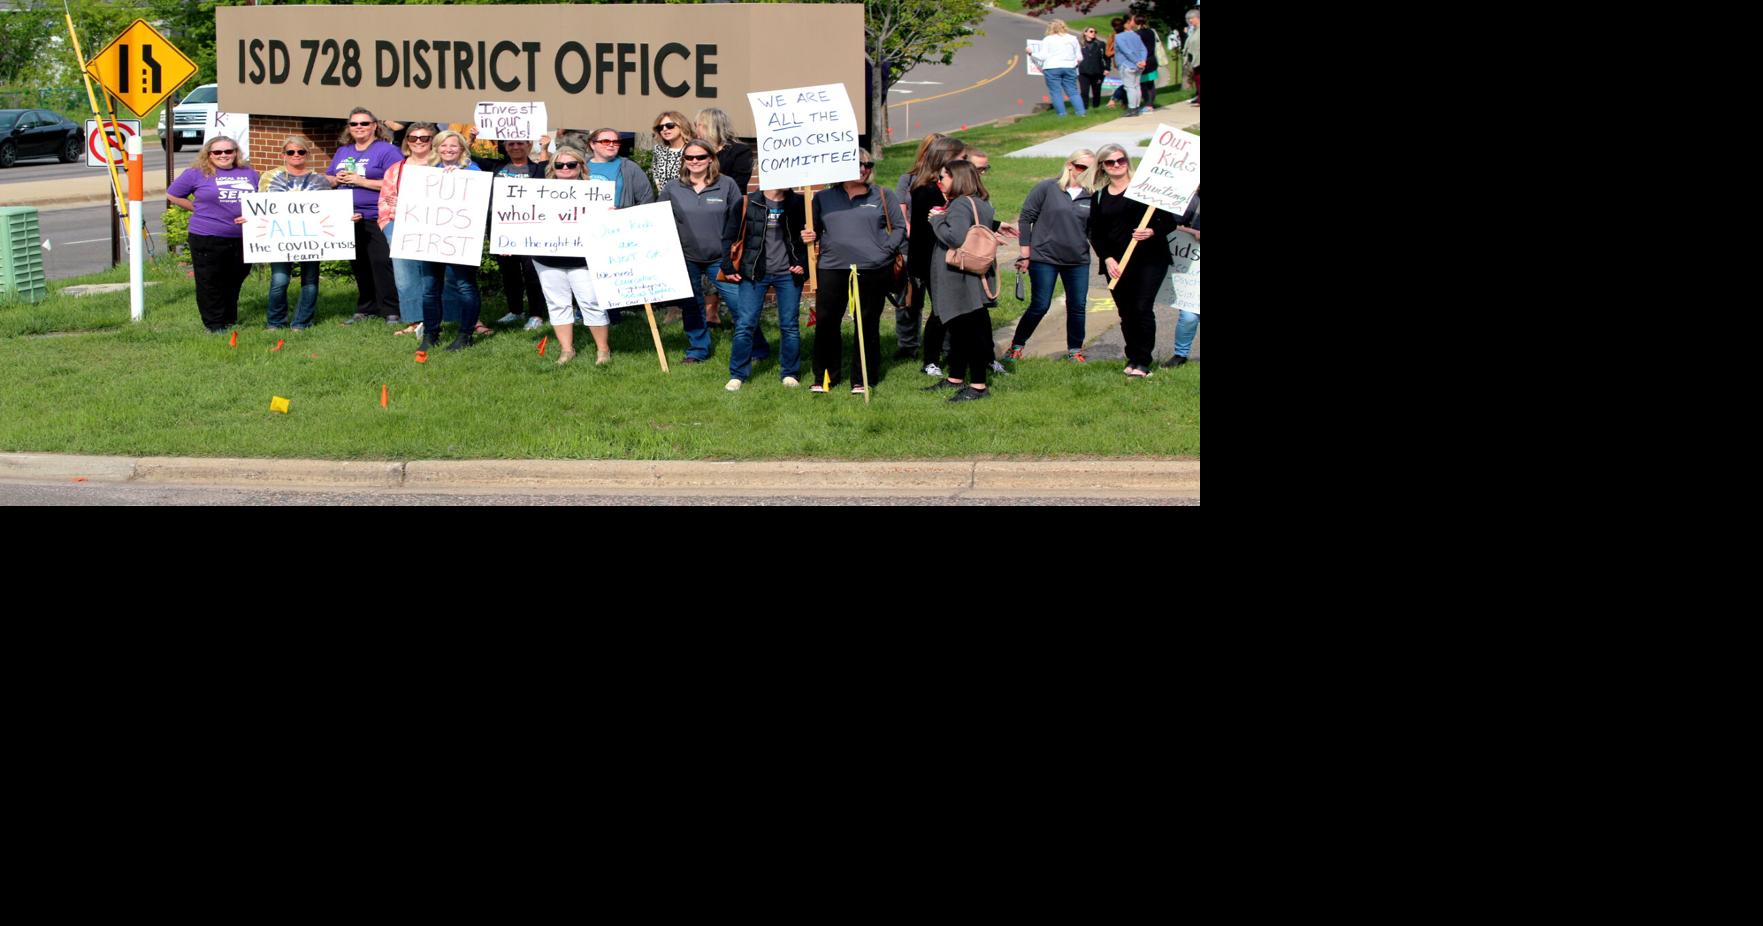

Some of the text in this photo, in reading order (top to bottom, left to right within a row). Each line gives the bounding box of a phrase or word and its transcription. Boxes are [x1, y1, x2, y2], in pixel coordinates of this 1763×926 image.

[239, 38, 718, 98] ISD 728 DISTRICT OFFICE
[478, 101, 538, 115] Invest
[757, 91, 831, 108] WE ARE
[480, 116, 521, 128] in our
[768, 110, 839, 127] ALL THE
[495, 121, 530, 139] Kids!
[762, 130, 854, 152] COVID CRISIS
[1158, 130, 1192, 151] Our
[760, 149, 857, 173] COMMITTEE!
[1157, 149, 1198, 173] Kids
[1150, 166, 1174, 178] are
[425, 174, 475, 201] PUT
[506, 184, 613, 201] It took the
[246, 198, 320, 216] We are
[404, 203, 471, 229] KIDS
[497, 204, 546, 221] whole
[269, 219, 319, 239] ALL
[249, 240, 355, 253] the COVID crisis
[401, 232, 475, 256] FIRST
[498, 235, 517, 248] Do
[524, 236, 541, 248] the
[544, 236, 570, 253] right
[287, 248, 324, 261] team!
